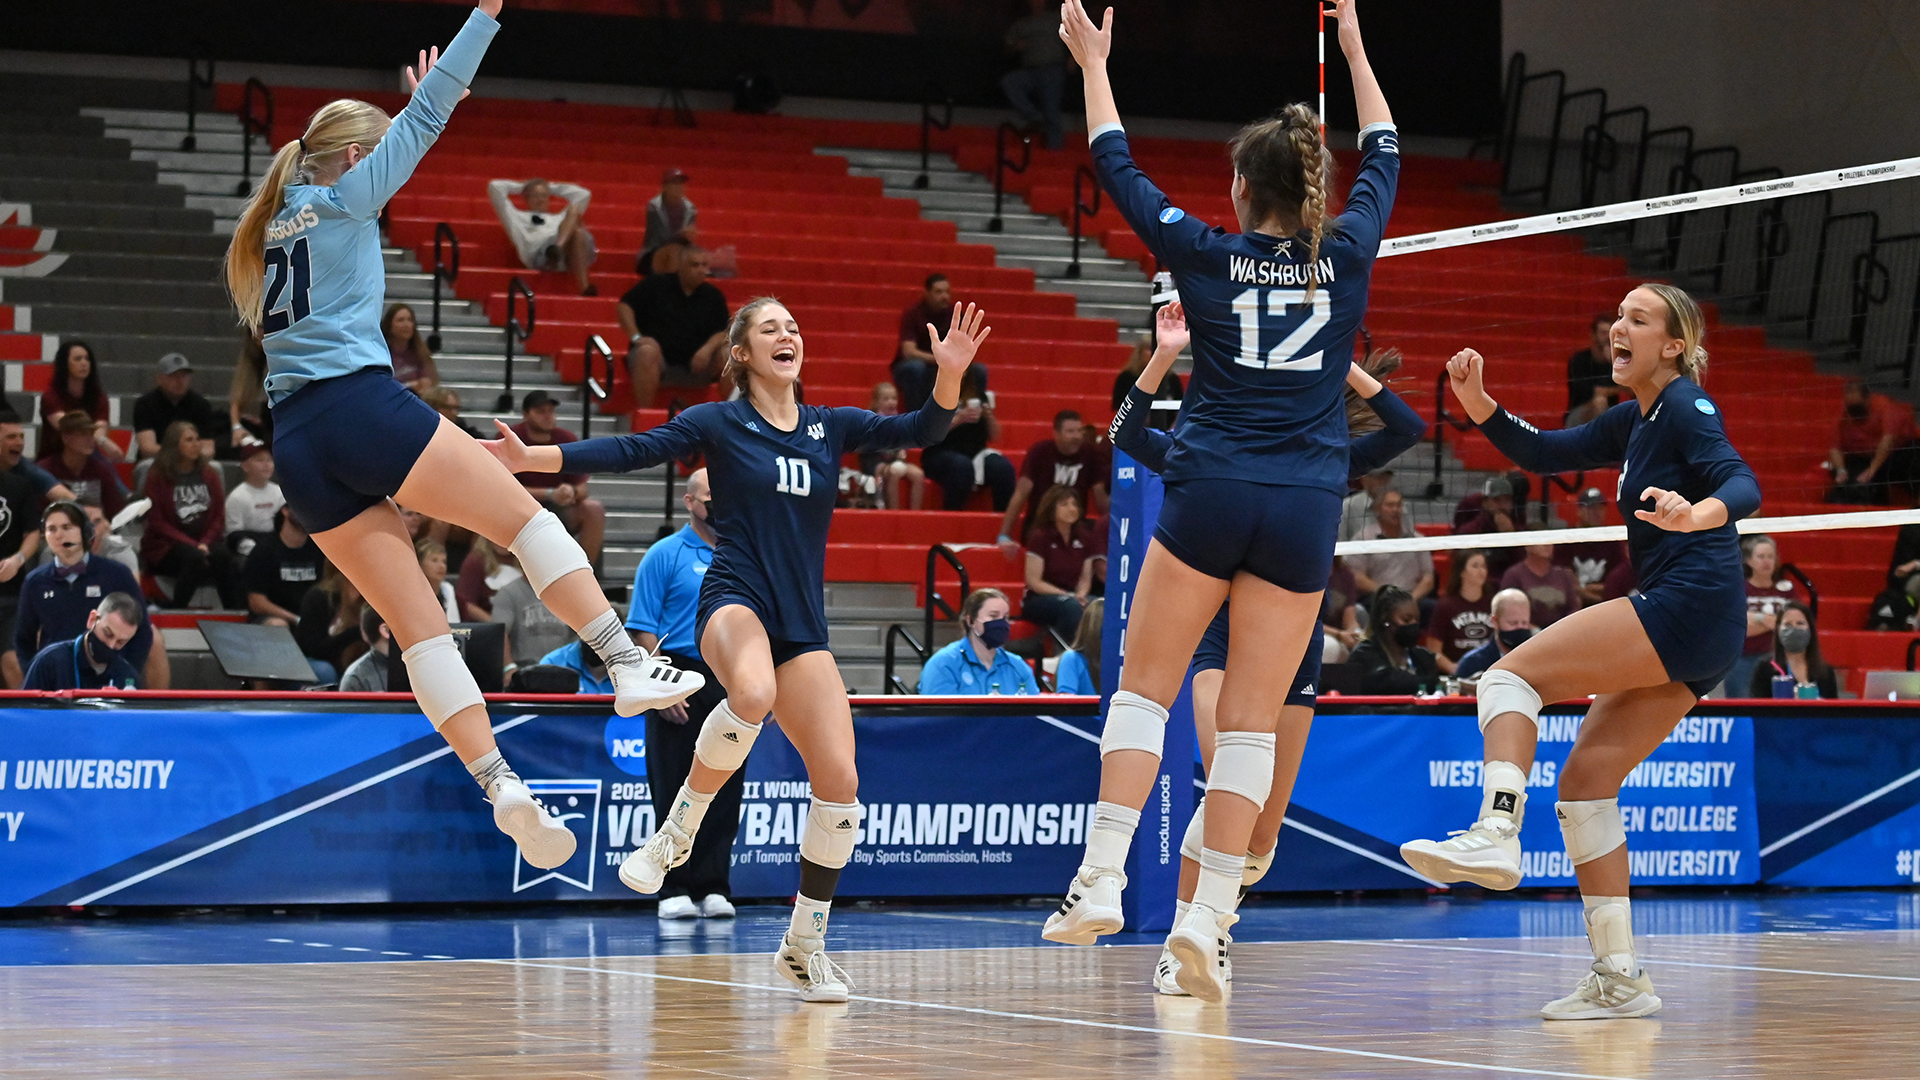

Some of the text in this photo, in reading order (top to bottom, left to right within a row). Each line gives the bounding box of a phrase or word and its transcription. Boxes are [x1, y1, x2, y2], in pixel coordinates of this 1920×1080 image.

[1866, 165, 1897, 177] CHAMPIONSHIP
[1230, 254, 1335, 286] WASHBURN
[262, 235, 313, 338] 21
[1231, 288, 1332, 372] 12
[775, 455, 812, 498] 10
[1053, 461, 1084, 487] WT
[1537, 716, 1585, 742] ANN
[612, 739, 646, 759] NC
[15, 759, 175, 790] UNIVERSITY
[611, 782, 653, 801] 2021
[1159, 774, 1171, 815] sports
[854, 803, 1098, 846] CHAMPIONSHI
[1650, 806, 1738, 832] COLLEGE
[740, 849, 753, 864] of
[755, 850, 792, 867] Tampa
[854, 850, 874, 866] Bay
[876, 849, 911, 866] Sports
[913, 850, 979, 864] Commission,
[981, 850, 1012, 864] Hosts
